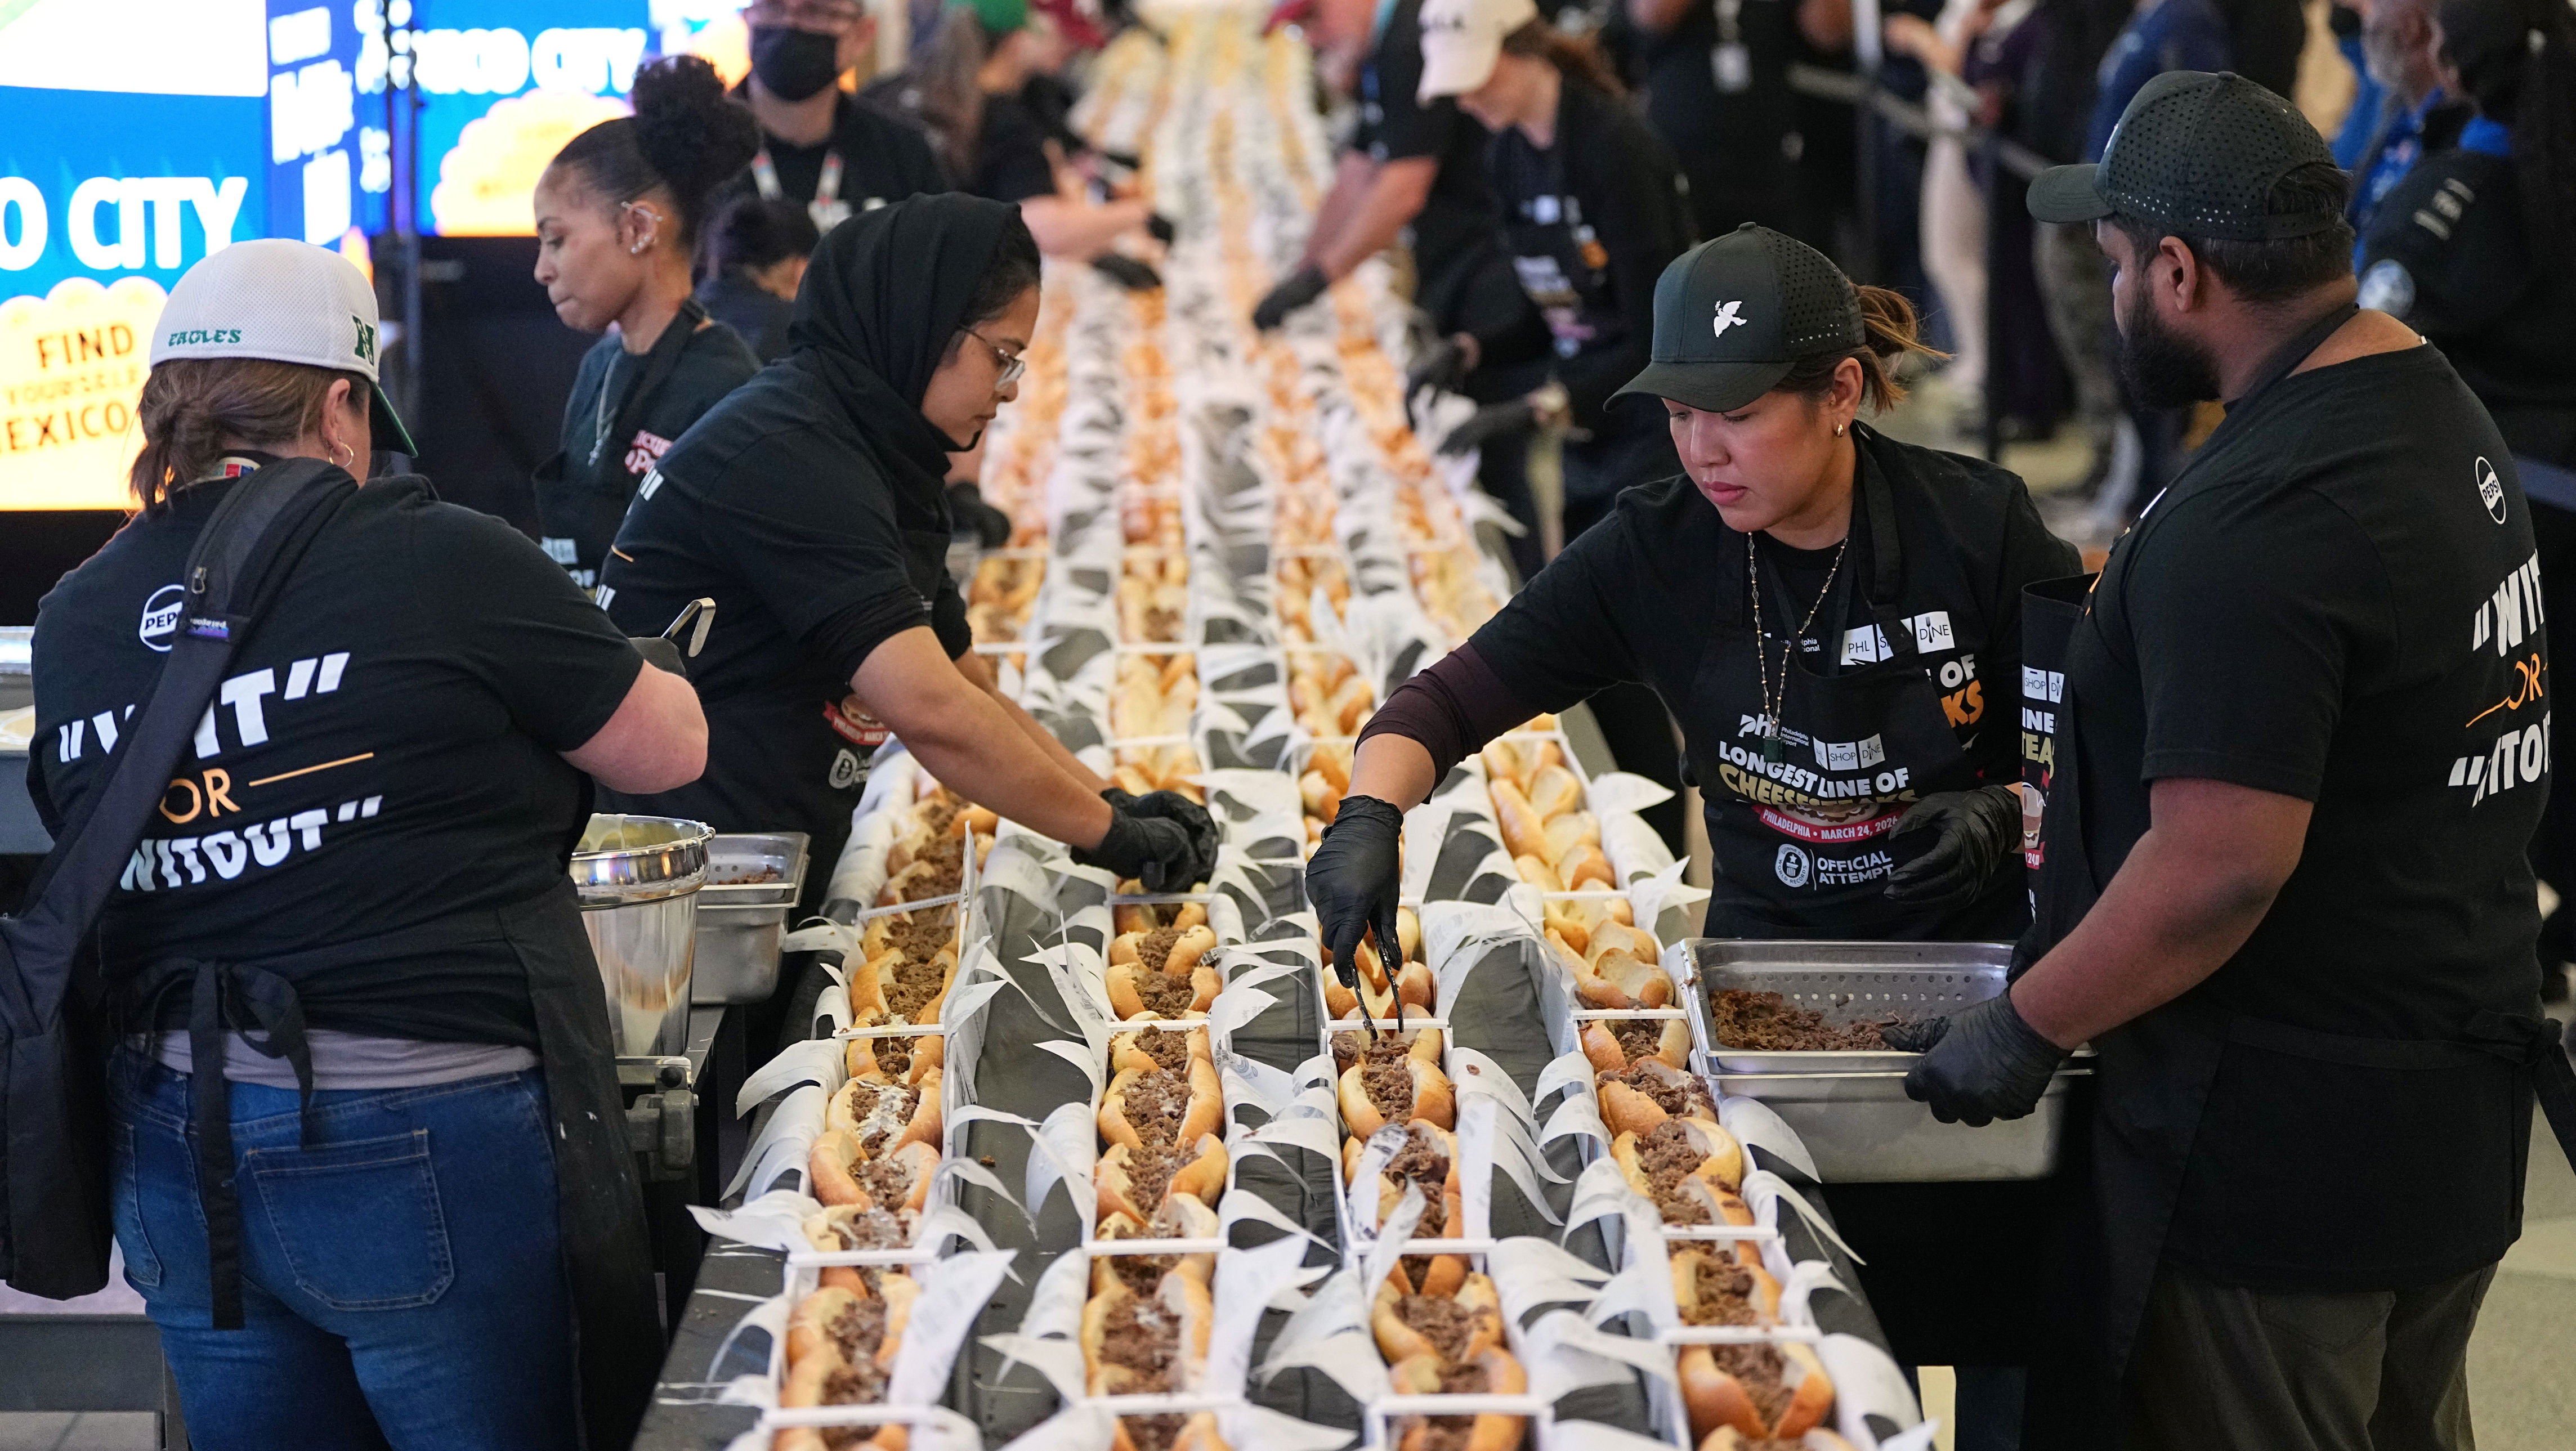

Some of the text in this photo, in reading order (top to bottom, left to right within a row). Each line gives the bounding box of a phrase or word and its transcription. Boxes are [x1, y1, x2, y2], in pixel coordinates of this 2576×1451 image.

[68, 176, 248, 269] CITY
[37, 325, 133, 368] FIND
[169, 329, 242, 347] EAGLES
[7, 401, 128, 450] EXICO
[2482, 479, 2501, 502] PEPSI
[1848, 641, 1870, 653] PHL
[1940, 654, 1976, 688] OF
[2025, 677, 2046, 690] SHOP
[1781, 727, 1809, 741] Philadelphia
[1781, 732, 1809, 747] International
[1830, 752, 1856, 762] SHOP
[1719, 741, 1909, 798] LONGEST LINE OF
[159, 768, 241, 823] OR
[1763, 809, 1812, 838] PHILADELPHIA
[1821, 826, 1855, 840] MARCH
[1857, 825, 1873, 837] 24,
[1778, 859, 1807, 884] WORLD RECORDS
[1817, 850, 1893, 872] OFFICIAL
[1819, 863, 1894, 885] ATTEMPT
